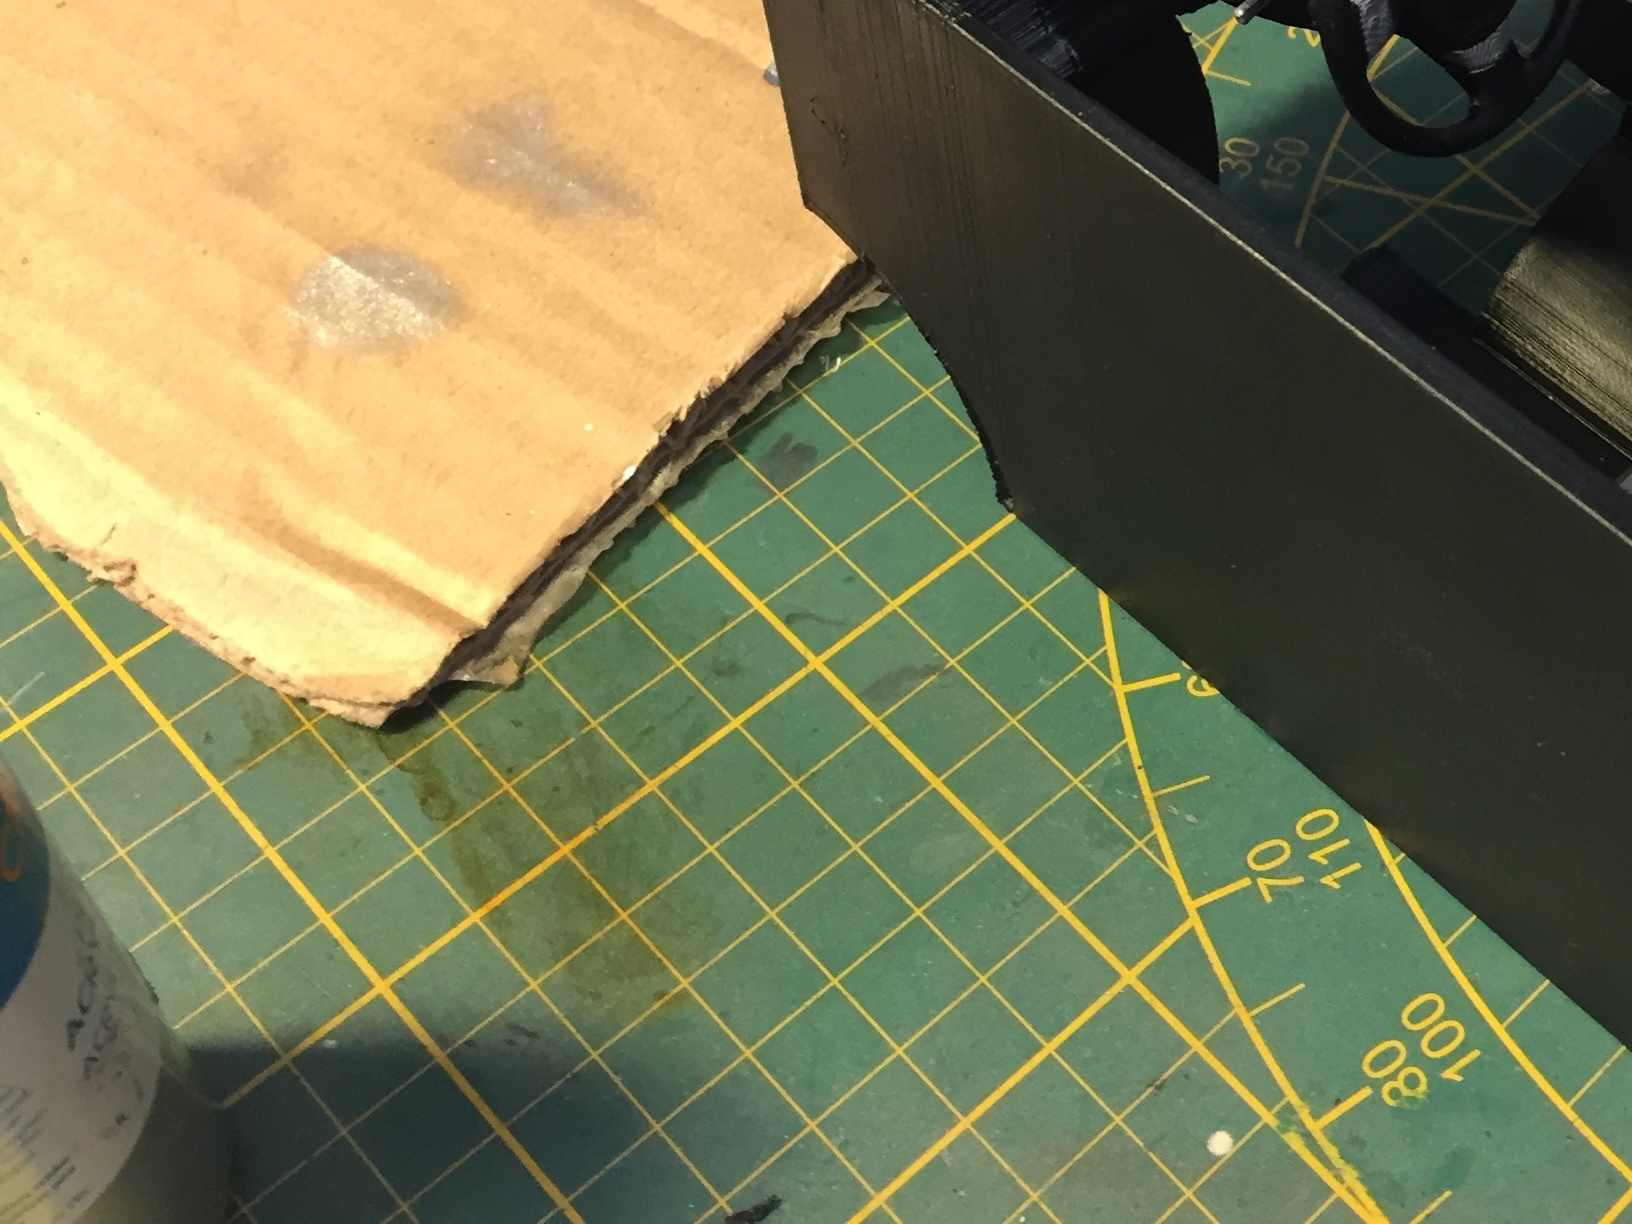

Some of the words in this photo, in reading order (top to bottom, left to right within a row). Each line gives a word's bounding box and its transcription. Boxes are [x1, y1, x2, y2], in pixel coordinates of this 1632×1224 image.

[1246, 838, 1305, 904] 70
[1295, 808, 1362, 890] 110
[1361, 1039, 1429, 1108] 80
[1401, 992, 1482, 1082] 100
